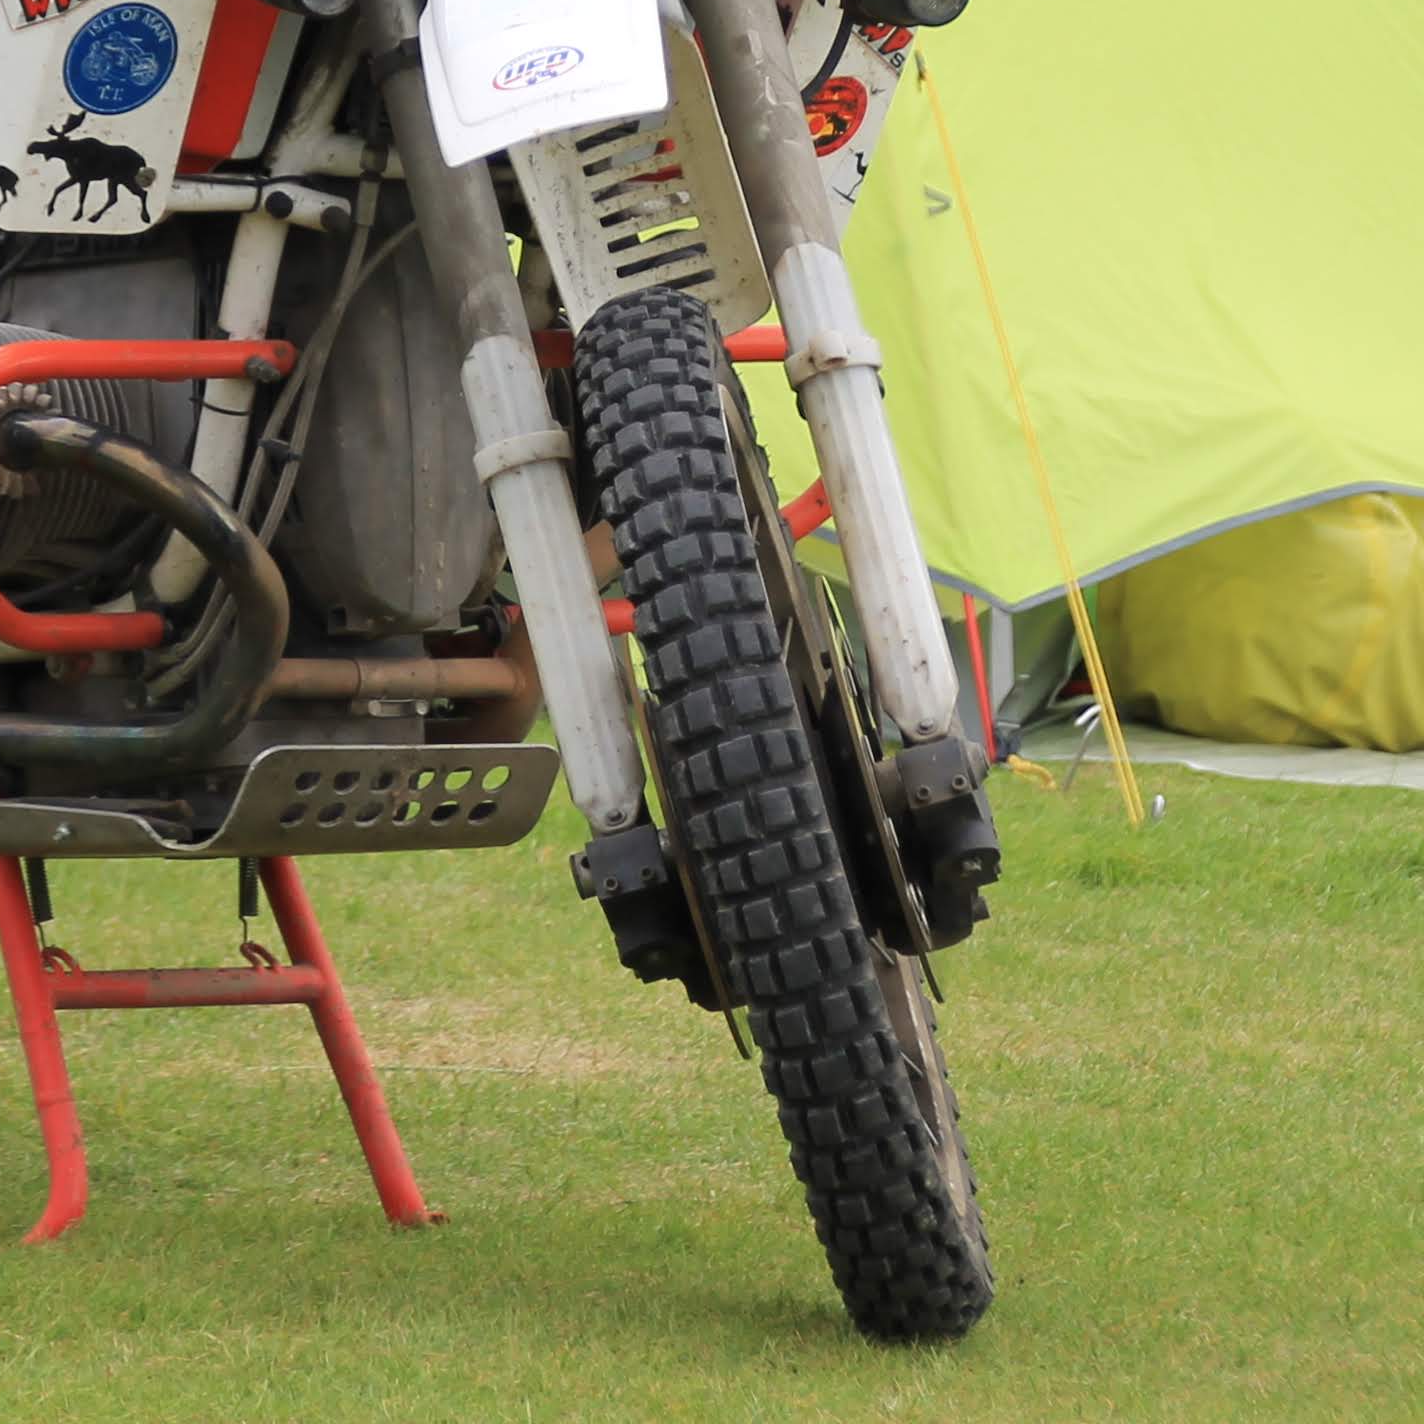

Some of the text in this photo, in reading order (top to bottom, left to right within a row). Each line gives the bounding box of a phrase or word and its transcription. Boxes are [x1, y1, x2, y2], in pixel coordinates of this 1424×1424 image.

[87, 9, 171, 43] ISLE OF MAN
